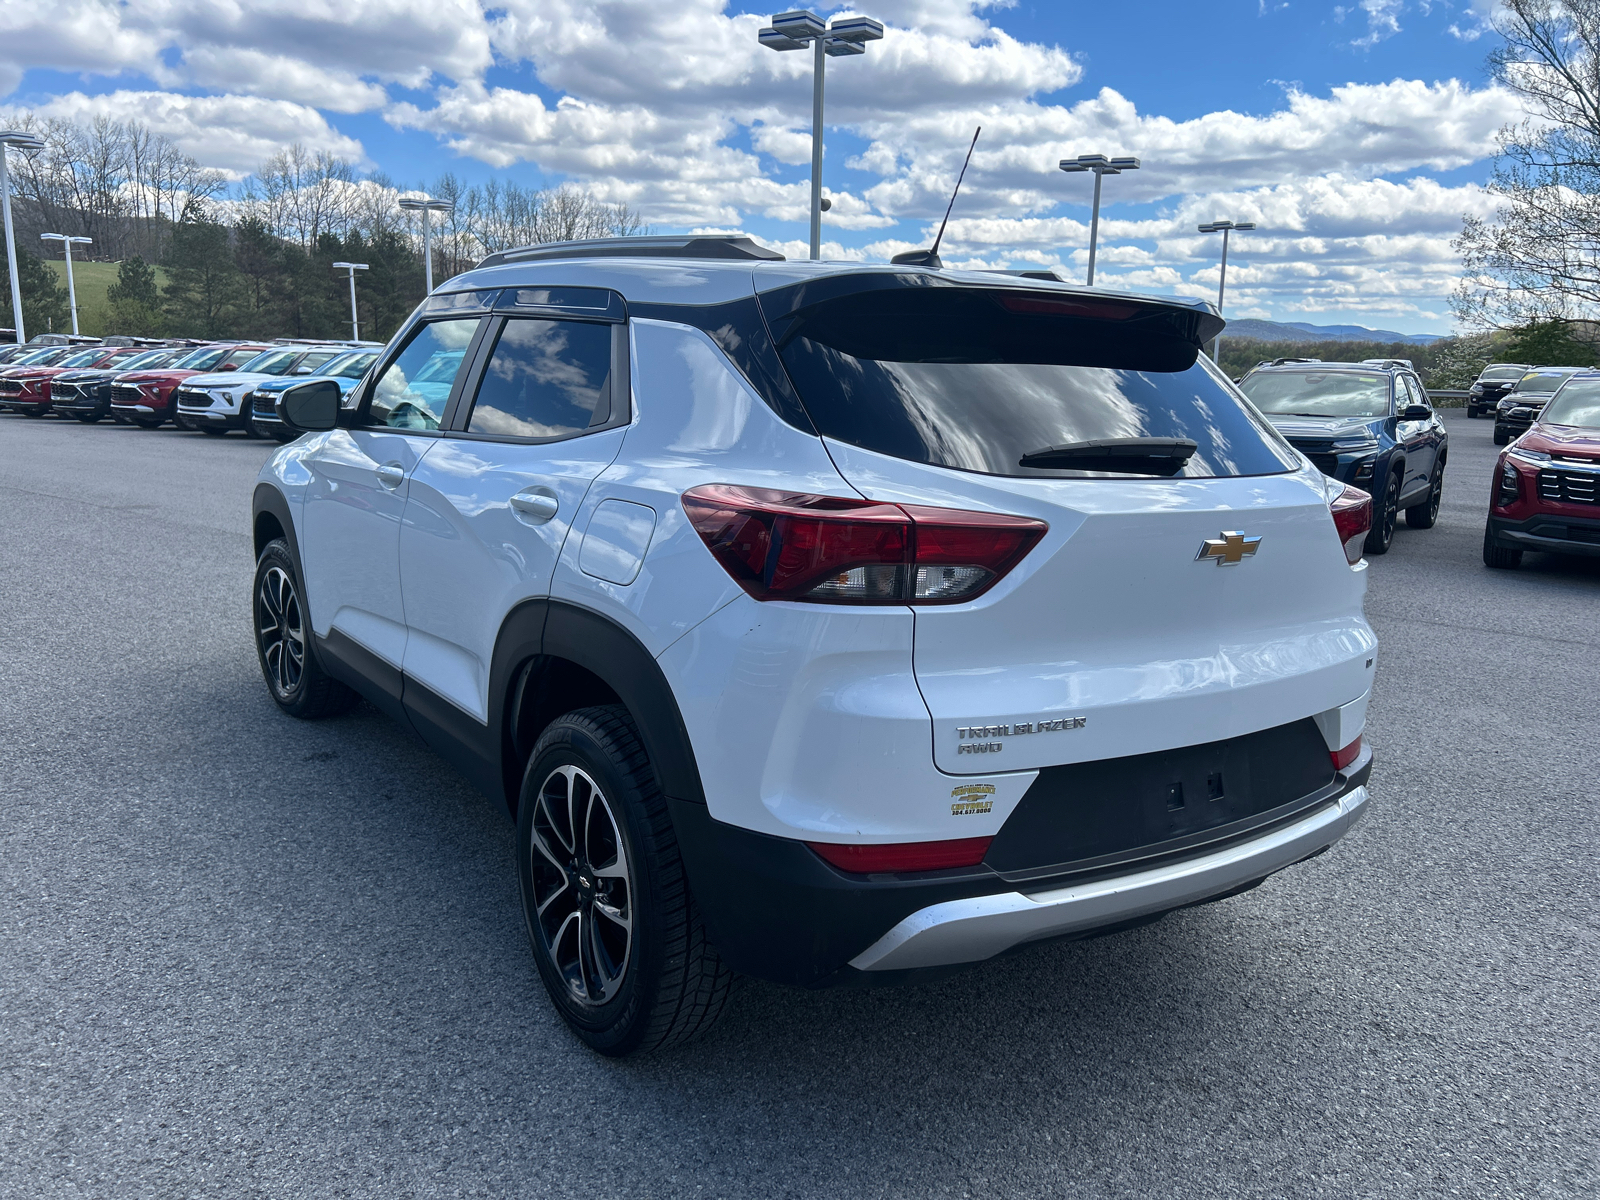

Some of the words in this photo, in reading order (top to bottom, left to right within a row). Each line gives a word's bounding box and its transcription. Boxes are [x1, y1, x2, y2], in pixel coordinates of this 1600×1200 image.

[956, 716, 1087, 739] TRAILBLAZER
[957, 741, 1003, 755] AWD
[951, 787, 996, 797] PERFORMANCE
[951, 801, 993, 810] CHEVROLET
